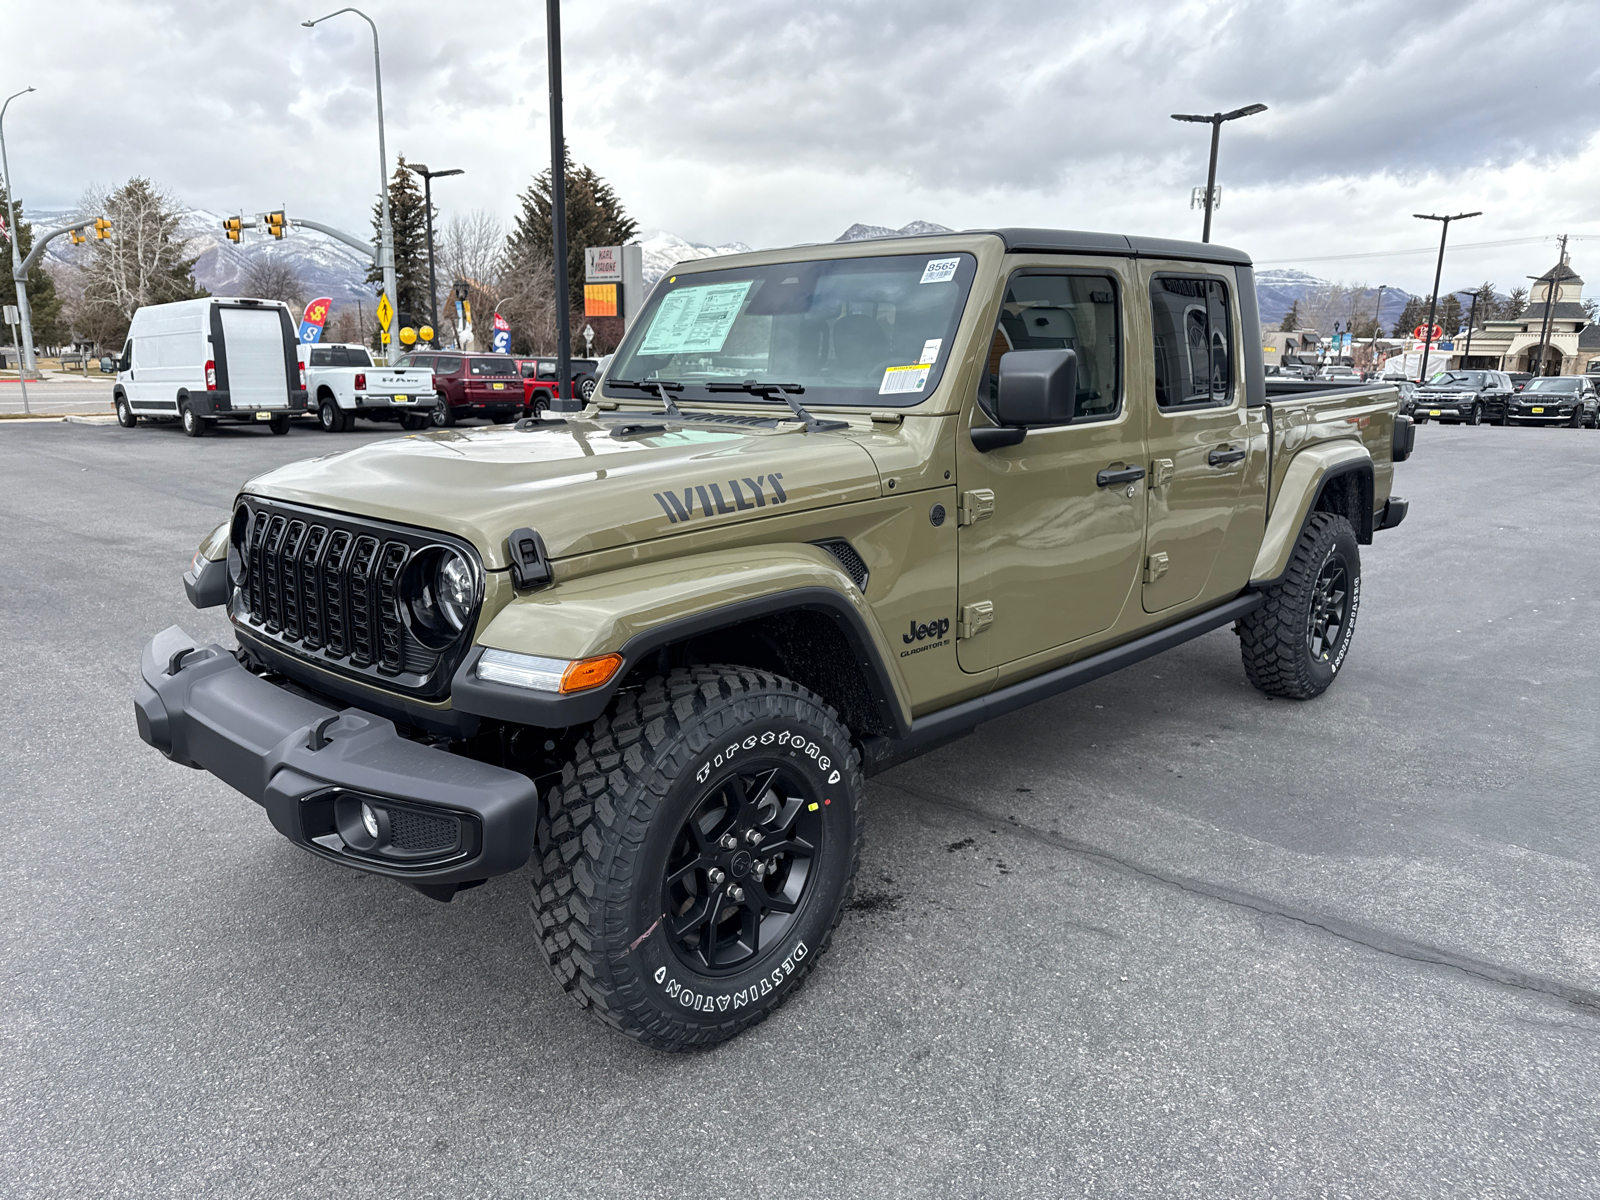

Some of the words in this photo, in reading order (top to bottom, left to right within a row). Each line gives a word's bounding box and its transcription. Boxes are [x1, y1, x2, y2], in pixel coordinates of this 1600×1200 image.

[595, 261, 617, 273] MALONE
[927, 261, 957, 272] 8565
[653, 472, 787, 524] WILLYS
[902, 617, 950, 644] Jeep
[900, 640, 943, 658] GLADIATOR
[696, 730, 831, 783] Firestone
[665, 941, 809, 1012] DESTINATION
